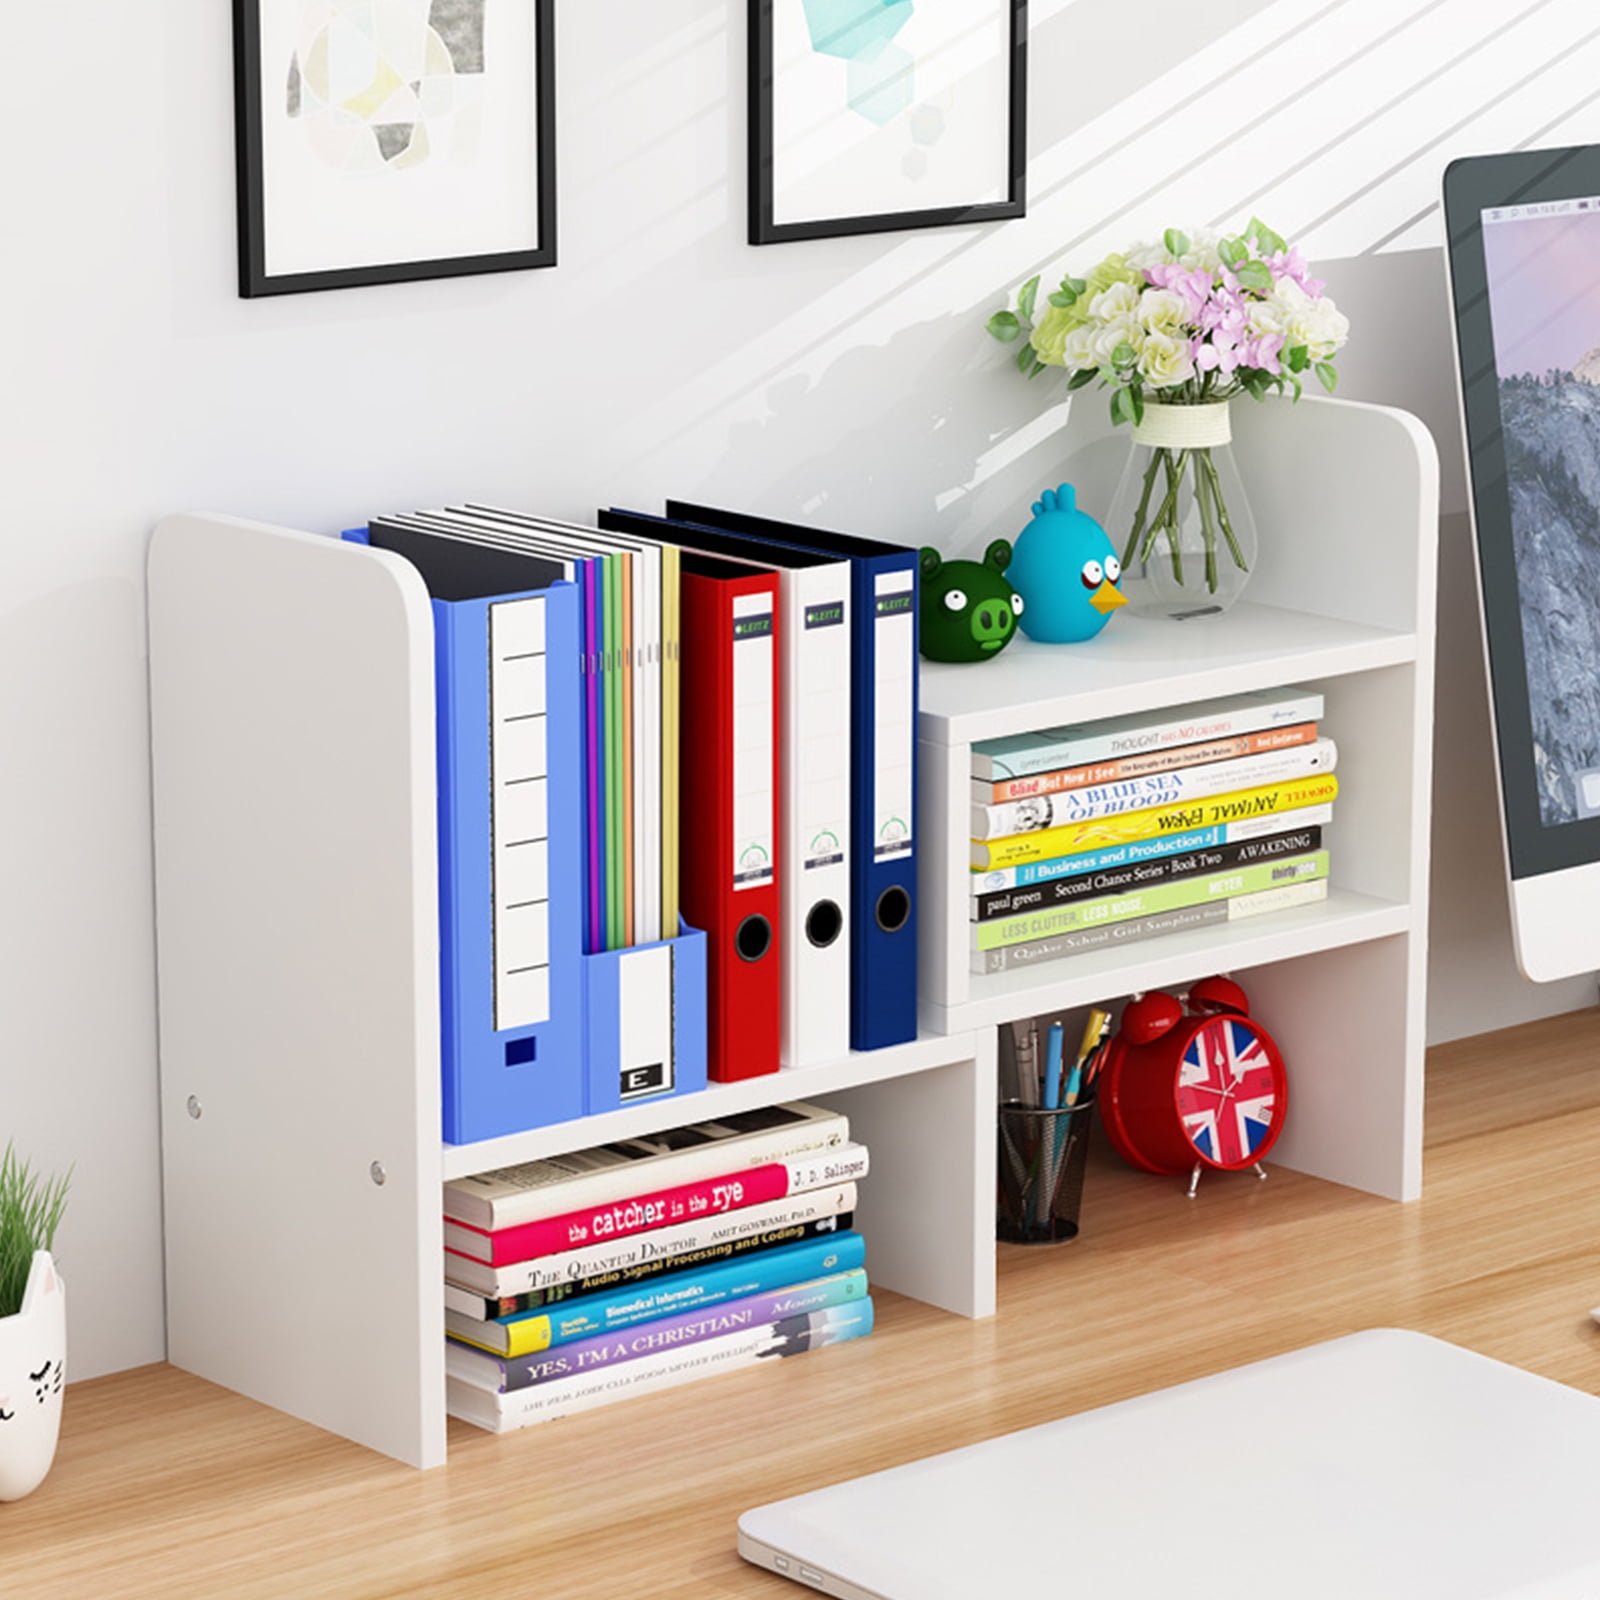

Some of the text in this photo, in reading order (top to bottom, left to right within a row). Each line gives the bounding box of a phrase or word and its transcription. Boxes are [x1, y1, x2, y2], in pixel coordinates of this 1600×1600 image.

[813, 608, 841, 622] LEITZ
[883, 598, 910, 611] LEITZ
[741, 620, 769, 633] LEITZ
[1111, 733, 1160, 753] THOUGHT
[1179, 725, 1195, 740] NO
[1010, 779, 1039, 797] Blind
[1095, 767, 1115, 781] See
[1066, 774, 1183, 808] A BLUE SEA
[1069, 790, 1179, 821] OF BLOOD
[1157, 807, 1204, 830] FARM
[1210, 792, 1279, 821] ANIMAL
[1037, 835, 1204, 878] Business and Production
[1237, 833, 1311, 861] AWAKENING
[1055, 853, 1223, 898] Second Chance Series Book Two
[1208, 876, 1244, 895] MEYER
[987, 892, 1042, 916] paul green
[1001, 923, 1028, 939] LESS
[1082, 904, 1109, 922] LESS
[1066, 931, 1109, 949] School
[1113, 925, 1142, 938] Girl
[1146, 913, 1201, 930] Samplers
[628, 1069, 649, 1090] E
[793, 1171, 806, 1187] J.
[824, 1159, 865, 1180] Salinger
[568, 1181, 744, 1242] the catcher in the rye
[711, 1226, 738, 1241] AMIT
[528, 1237, 697, 1288] THE QUANTUM DOCTOR
[582, 1225, 806, 1290] Audio Signal Processing and Coding
[771, 1293, 829, 1316] Moore
[526, 1357, 573, 1380] YES,
[577, 1348, 610, 1368] I'M
[612, 1342, 629, 1358] A
[631, 1309, 754, 1353] CHRISTIAN!
